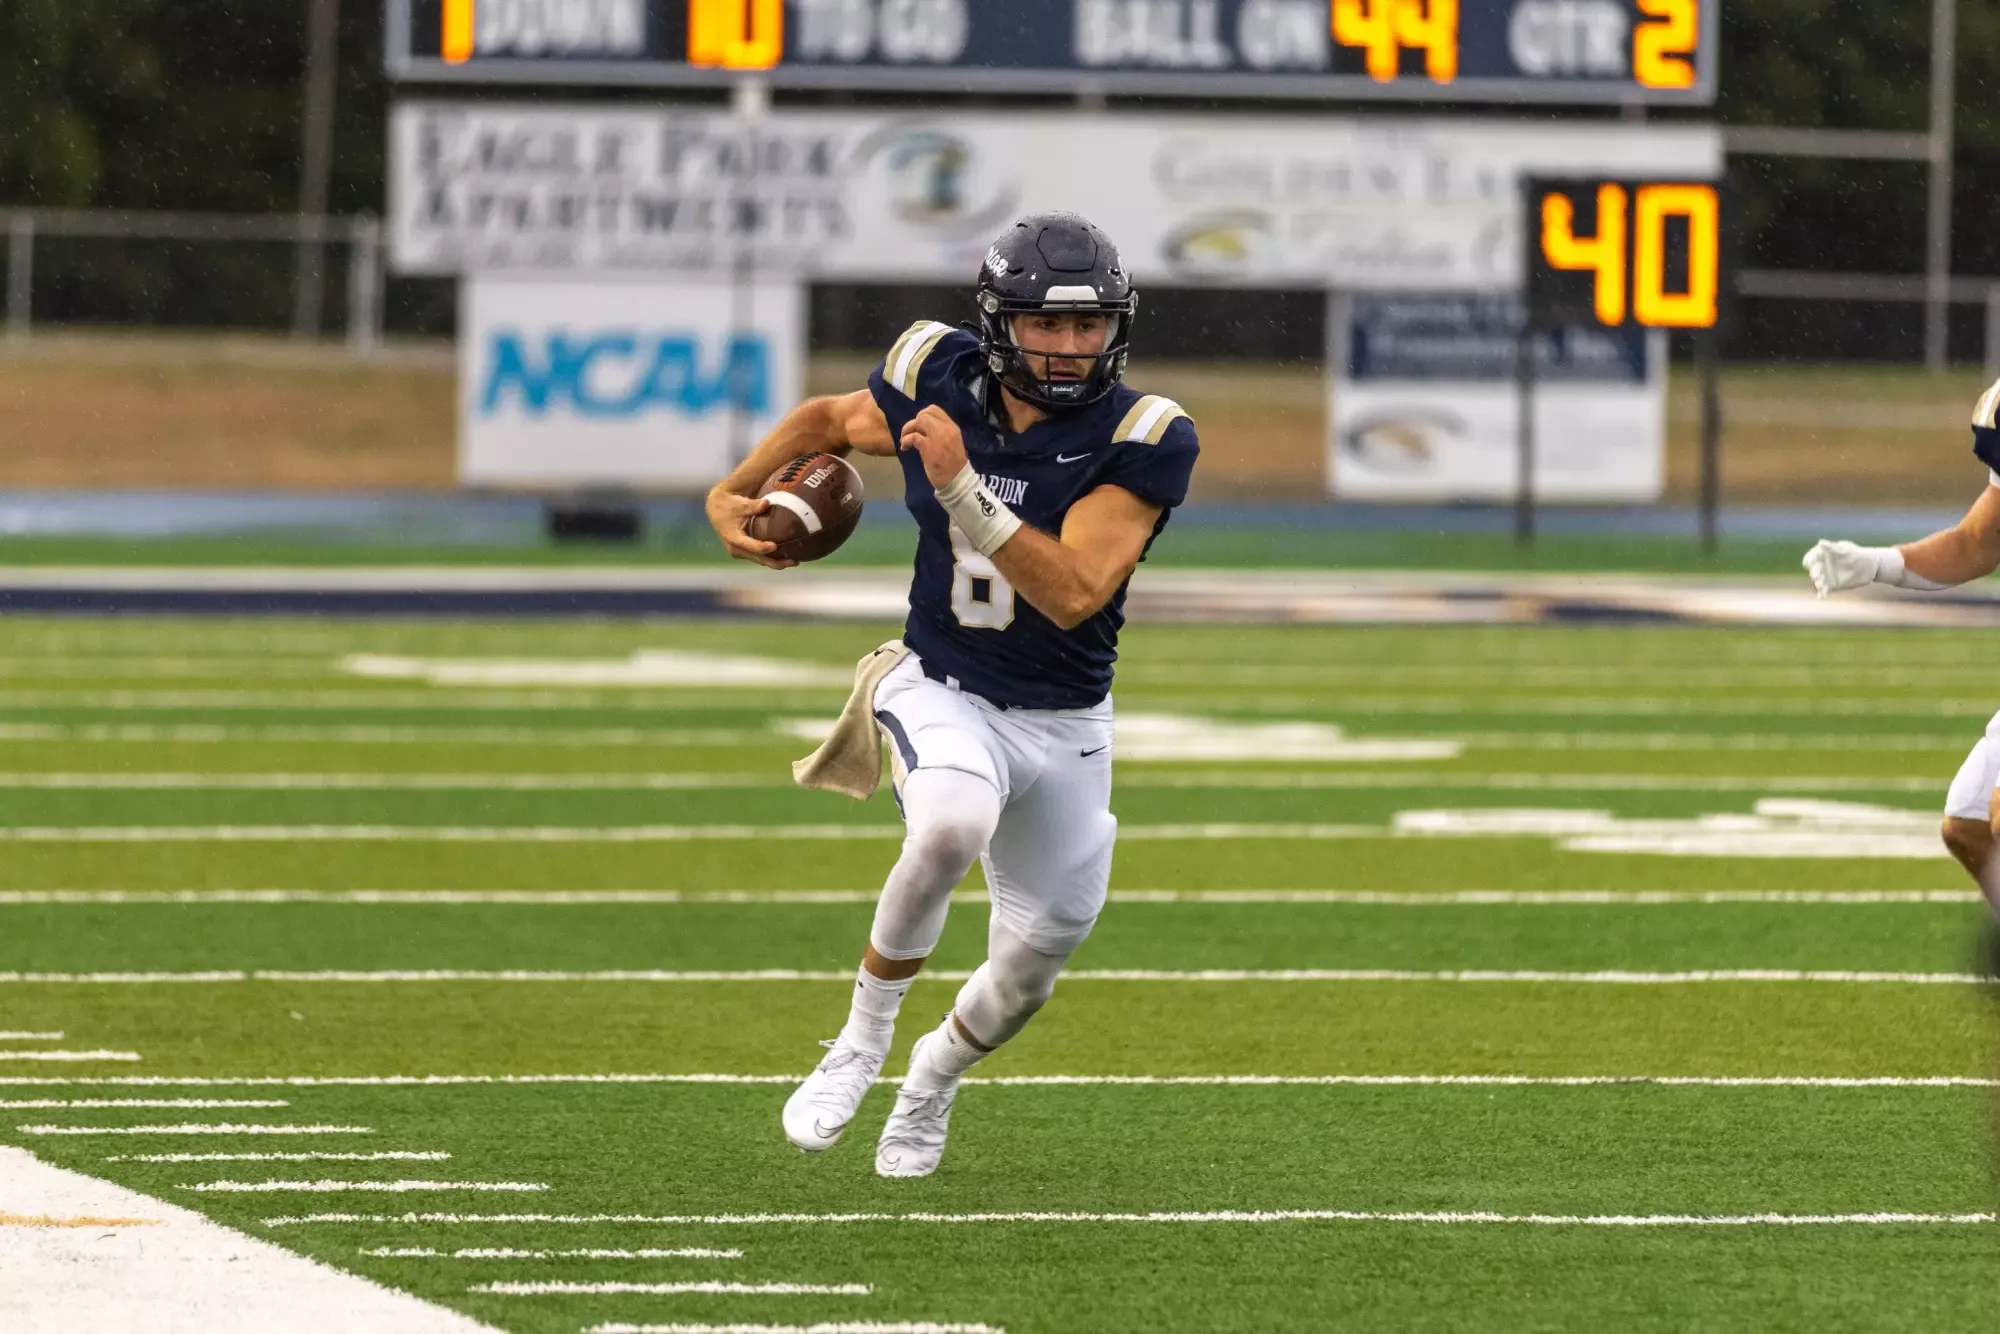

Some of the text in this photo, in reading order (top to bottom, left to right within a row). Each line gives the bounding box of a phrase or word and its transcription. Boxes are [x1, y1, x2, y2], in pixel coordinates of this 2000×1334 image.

[799, 0, 969, 62] TO GO
[1075, 0, 1328, 70] BALL ON
[1331, 0, 1460, 84] 44
[1633, 0, 1698, 89] 2
[1540, 182, 1719, 328] 40
[480, 328, 772, 418] NCAA
[803, 463, 840, 489] Wilson
